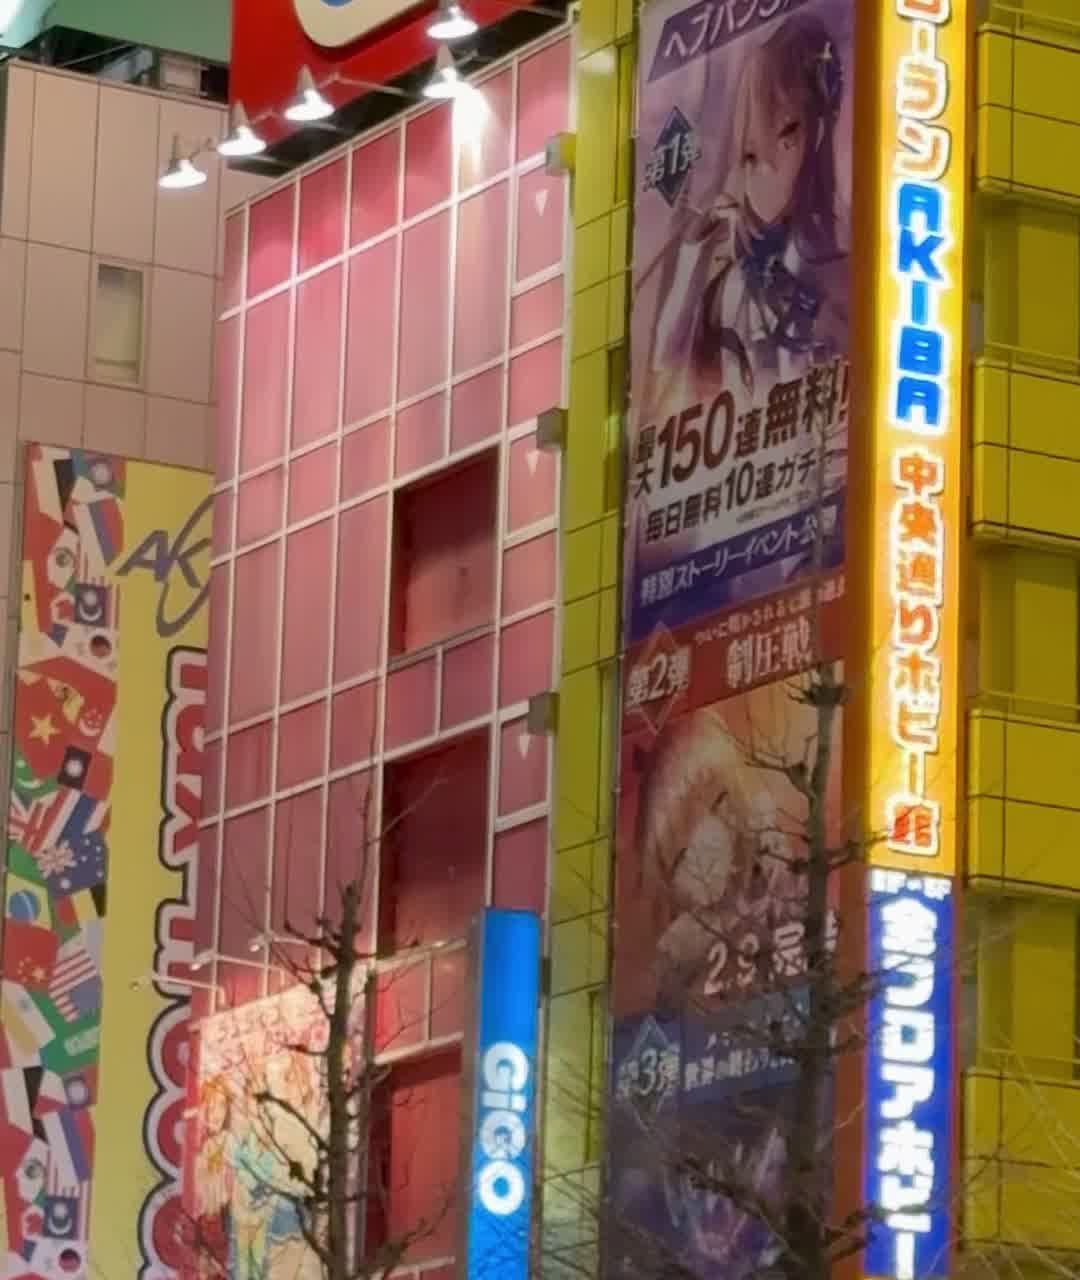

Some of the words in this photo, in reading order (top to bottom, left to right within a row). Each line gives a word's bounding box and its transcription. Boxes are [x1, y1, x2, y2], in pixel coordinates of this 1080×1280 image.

[645, 447, 834, 545] 毎日無料10連ガチ
[479, 1041, 529, 1216] GiGO
